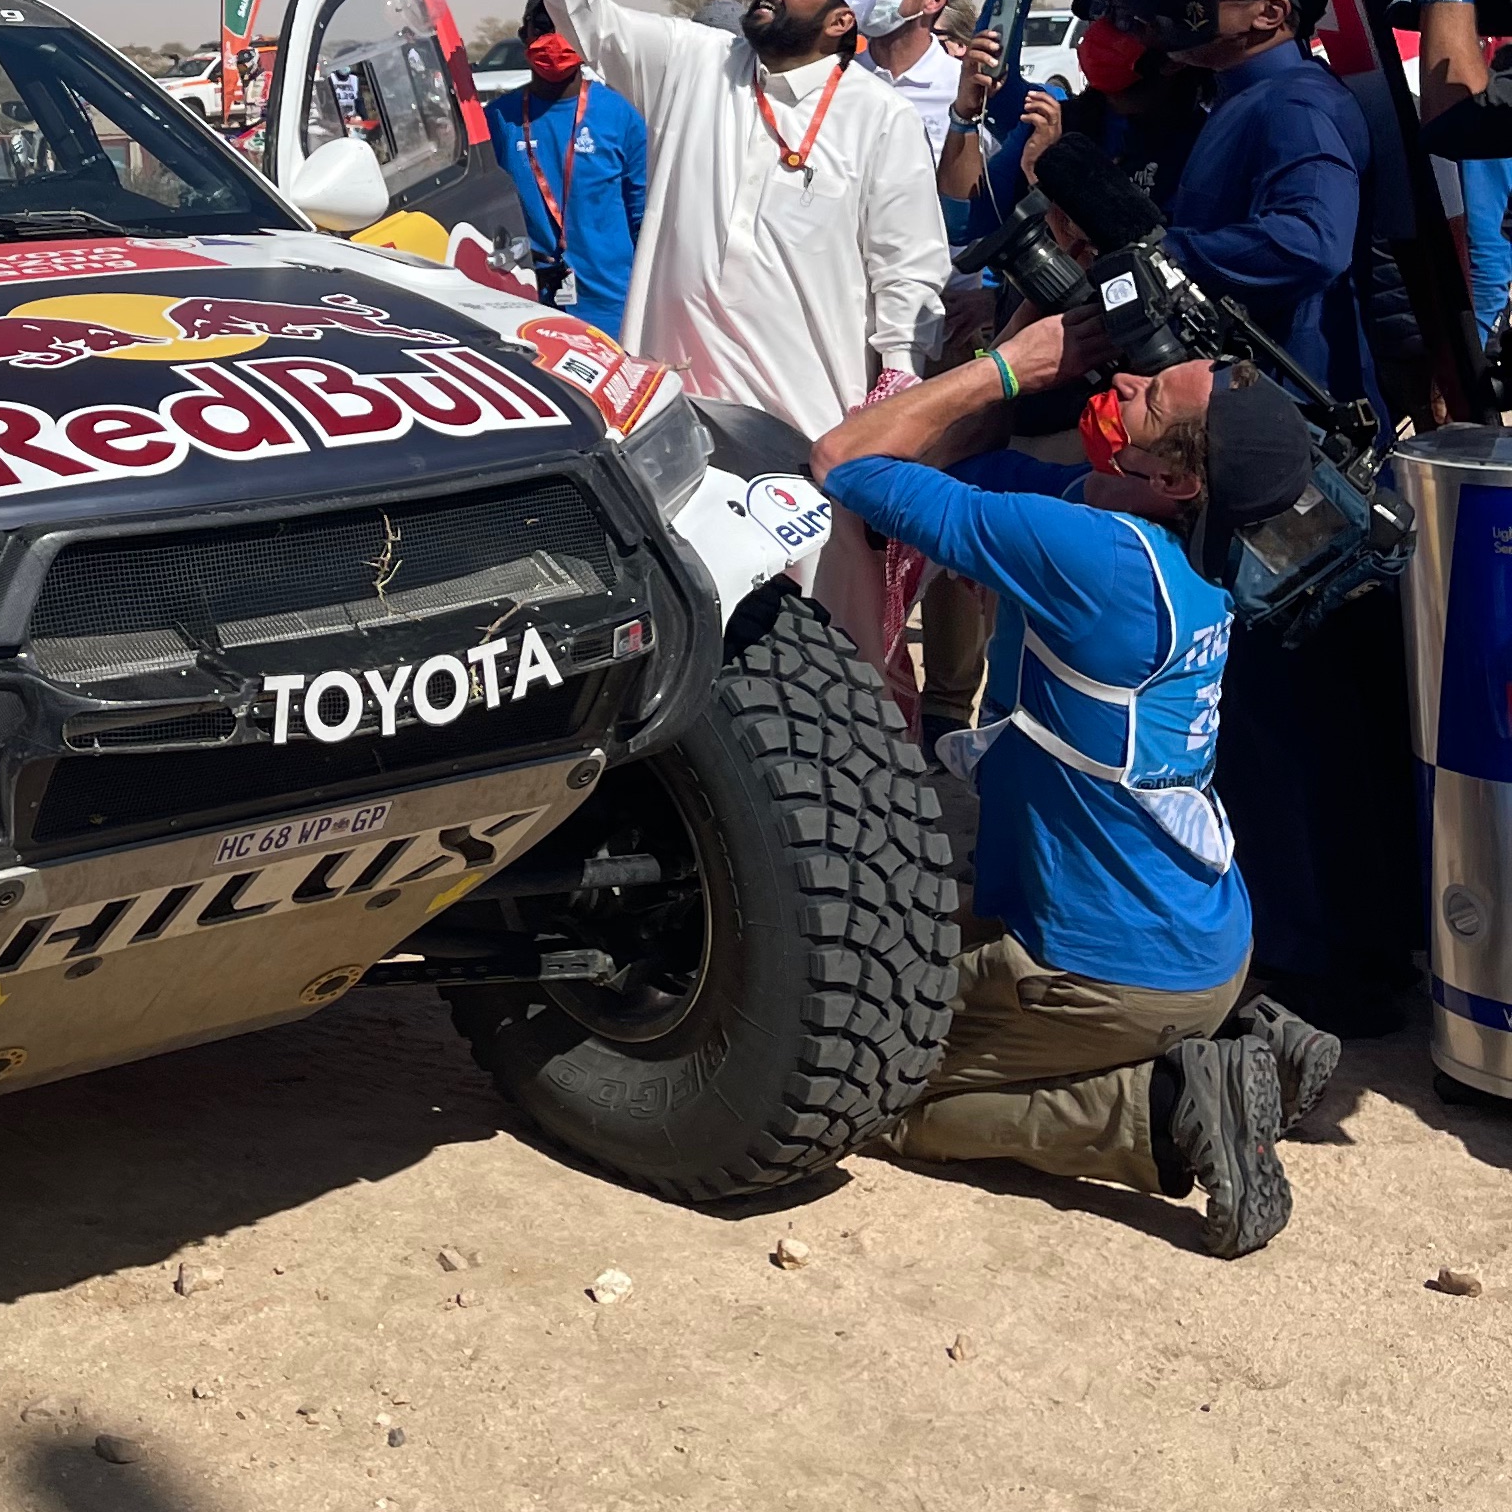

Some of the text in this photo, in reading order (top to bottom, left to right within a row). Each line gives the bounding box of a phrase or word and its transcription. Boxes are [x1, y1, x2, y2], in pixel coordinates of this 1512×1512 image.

[776, 502, 832, 546] euro
[264, 627, 564, 744] TOYOTA
[219, 804, 387, 862] HC 68 WP GP
